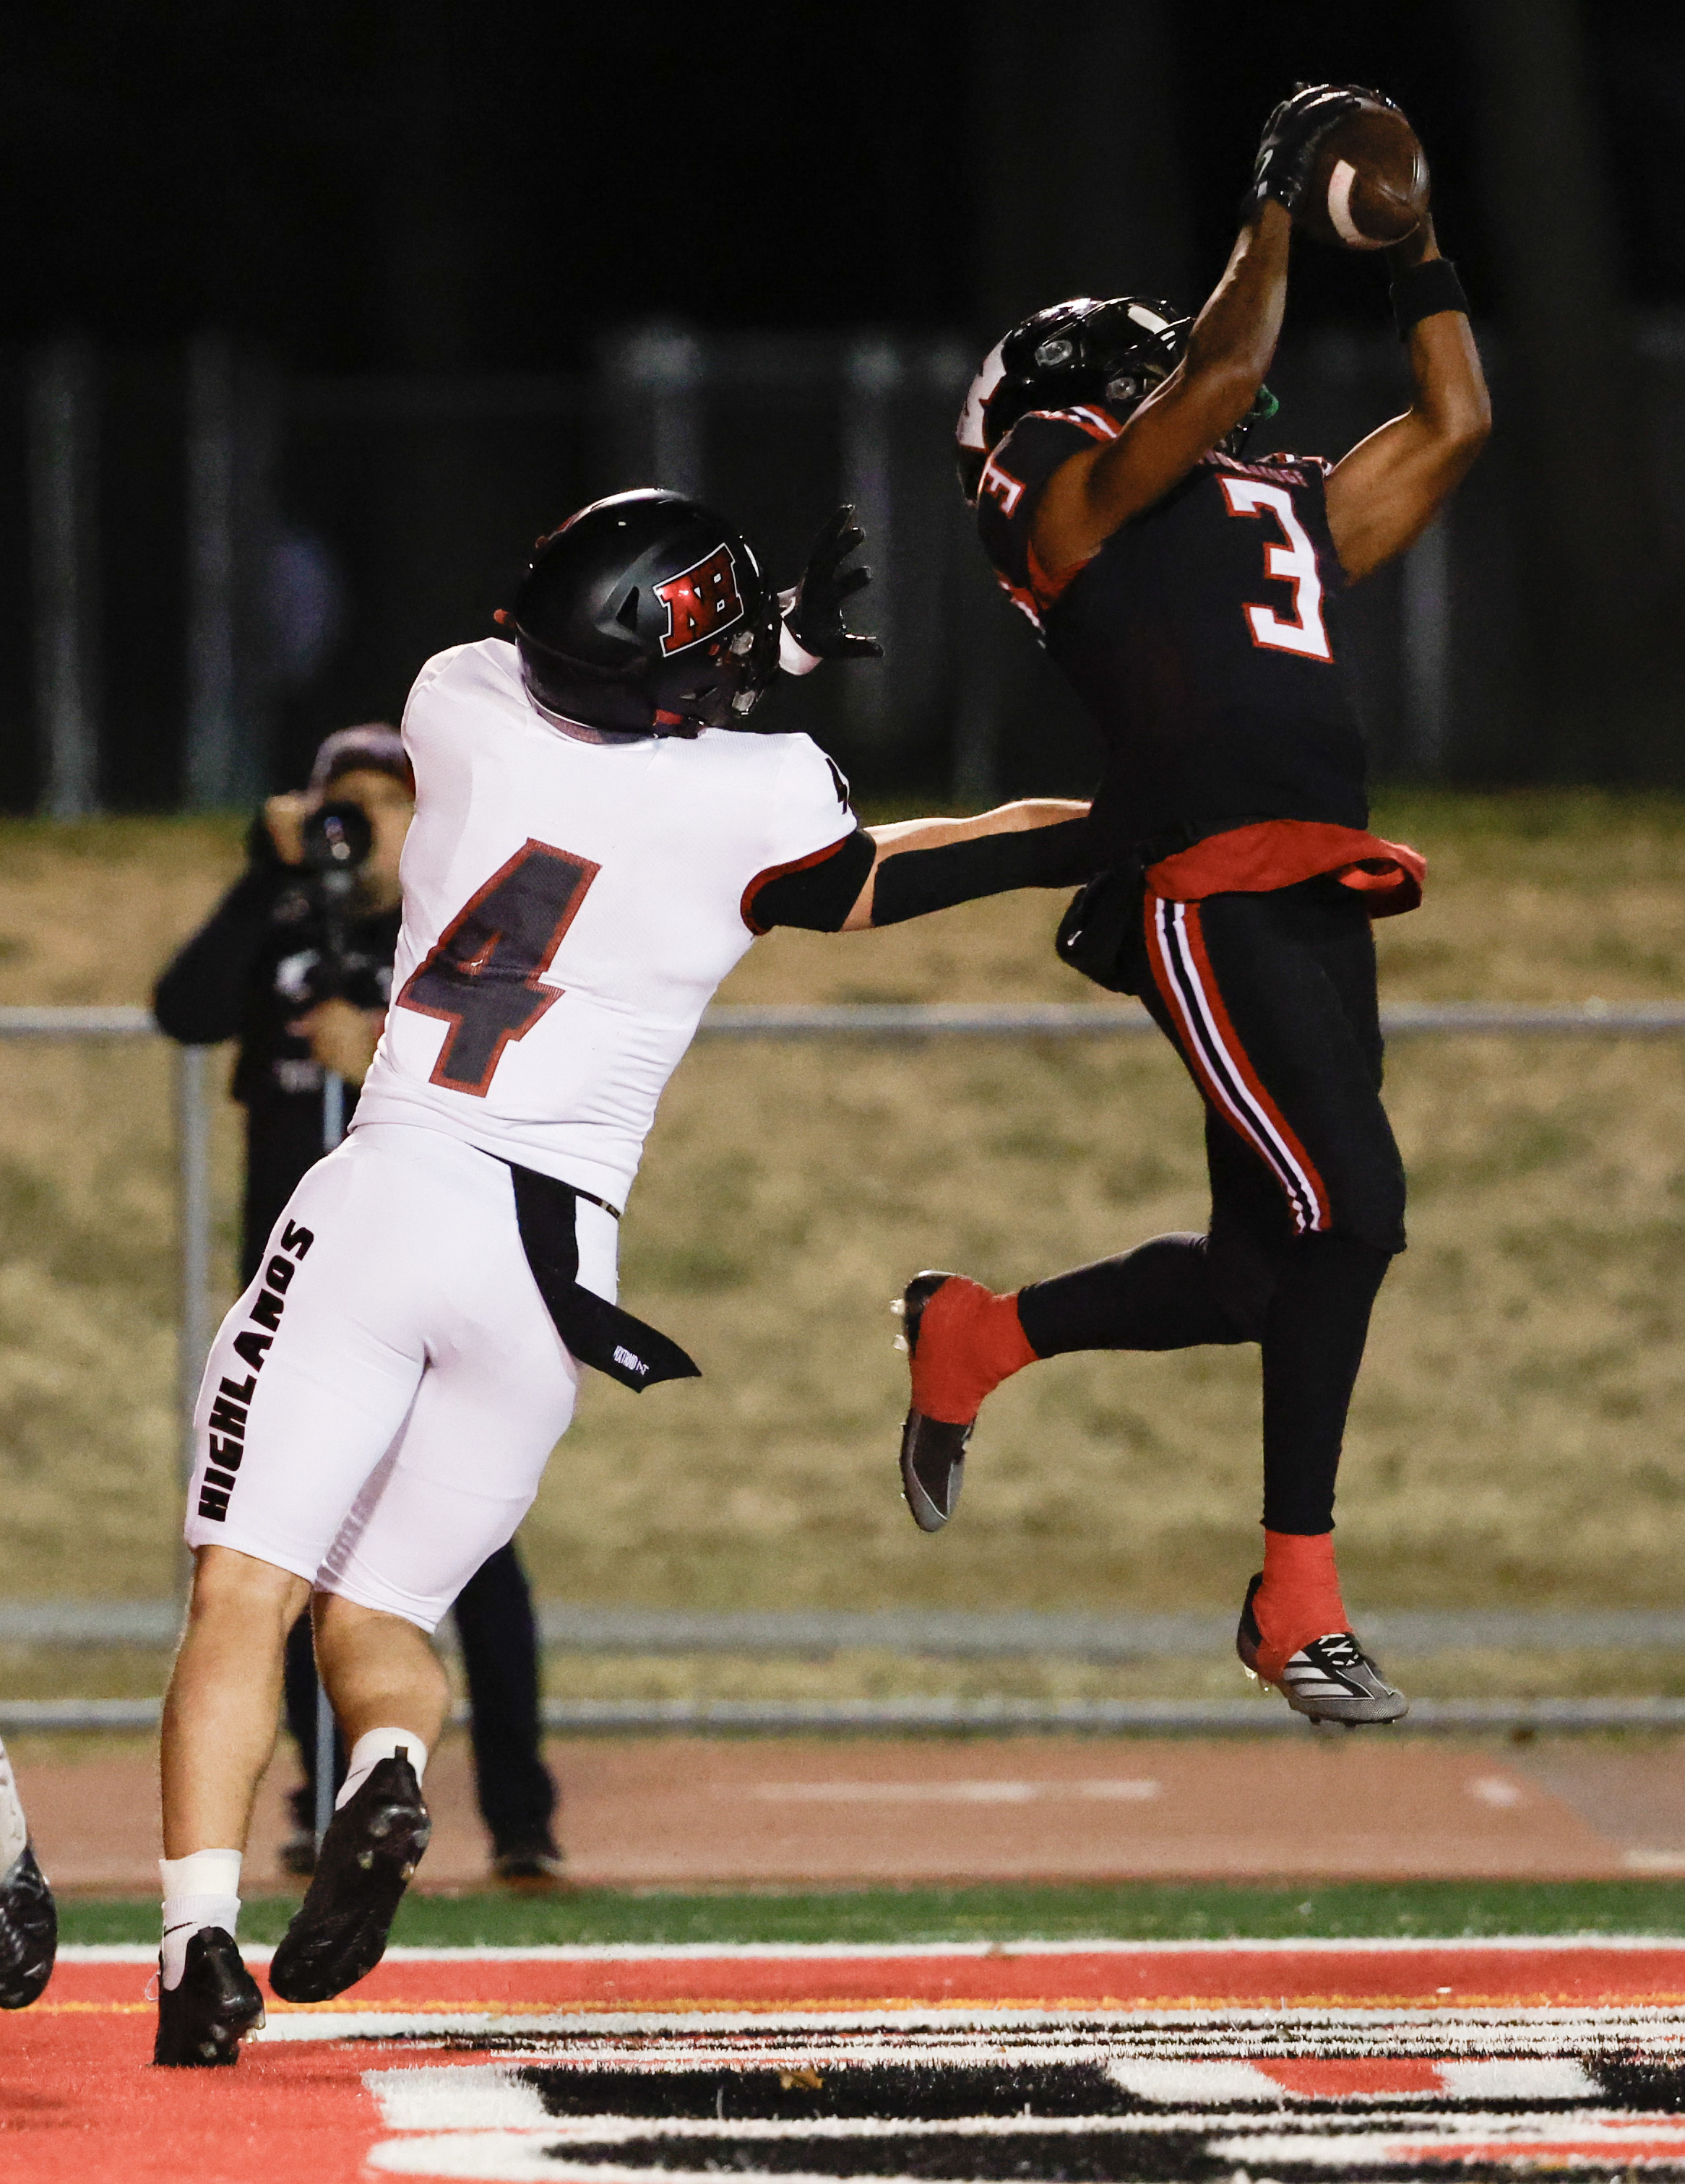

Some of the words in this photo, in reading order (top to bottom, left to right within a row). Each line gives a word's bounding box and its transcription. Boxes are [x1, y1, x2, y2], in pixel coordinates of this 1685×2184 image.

[1215, 472, 1335, 664] 3
[396, 837, 602, 1098] 4
[198, 1219, 314, 1522] HIGHLANDS
